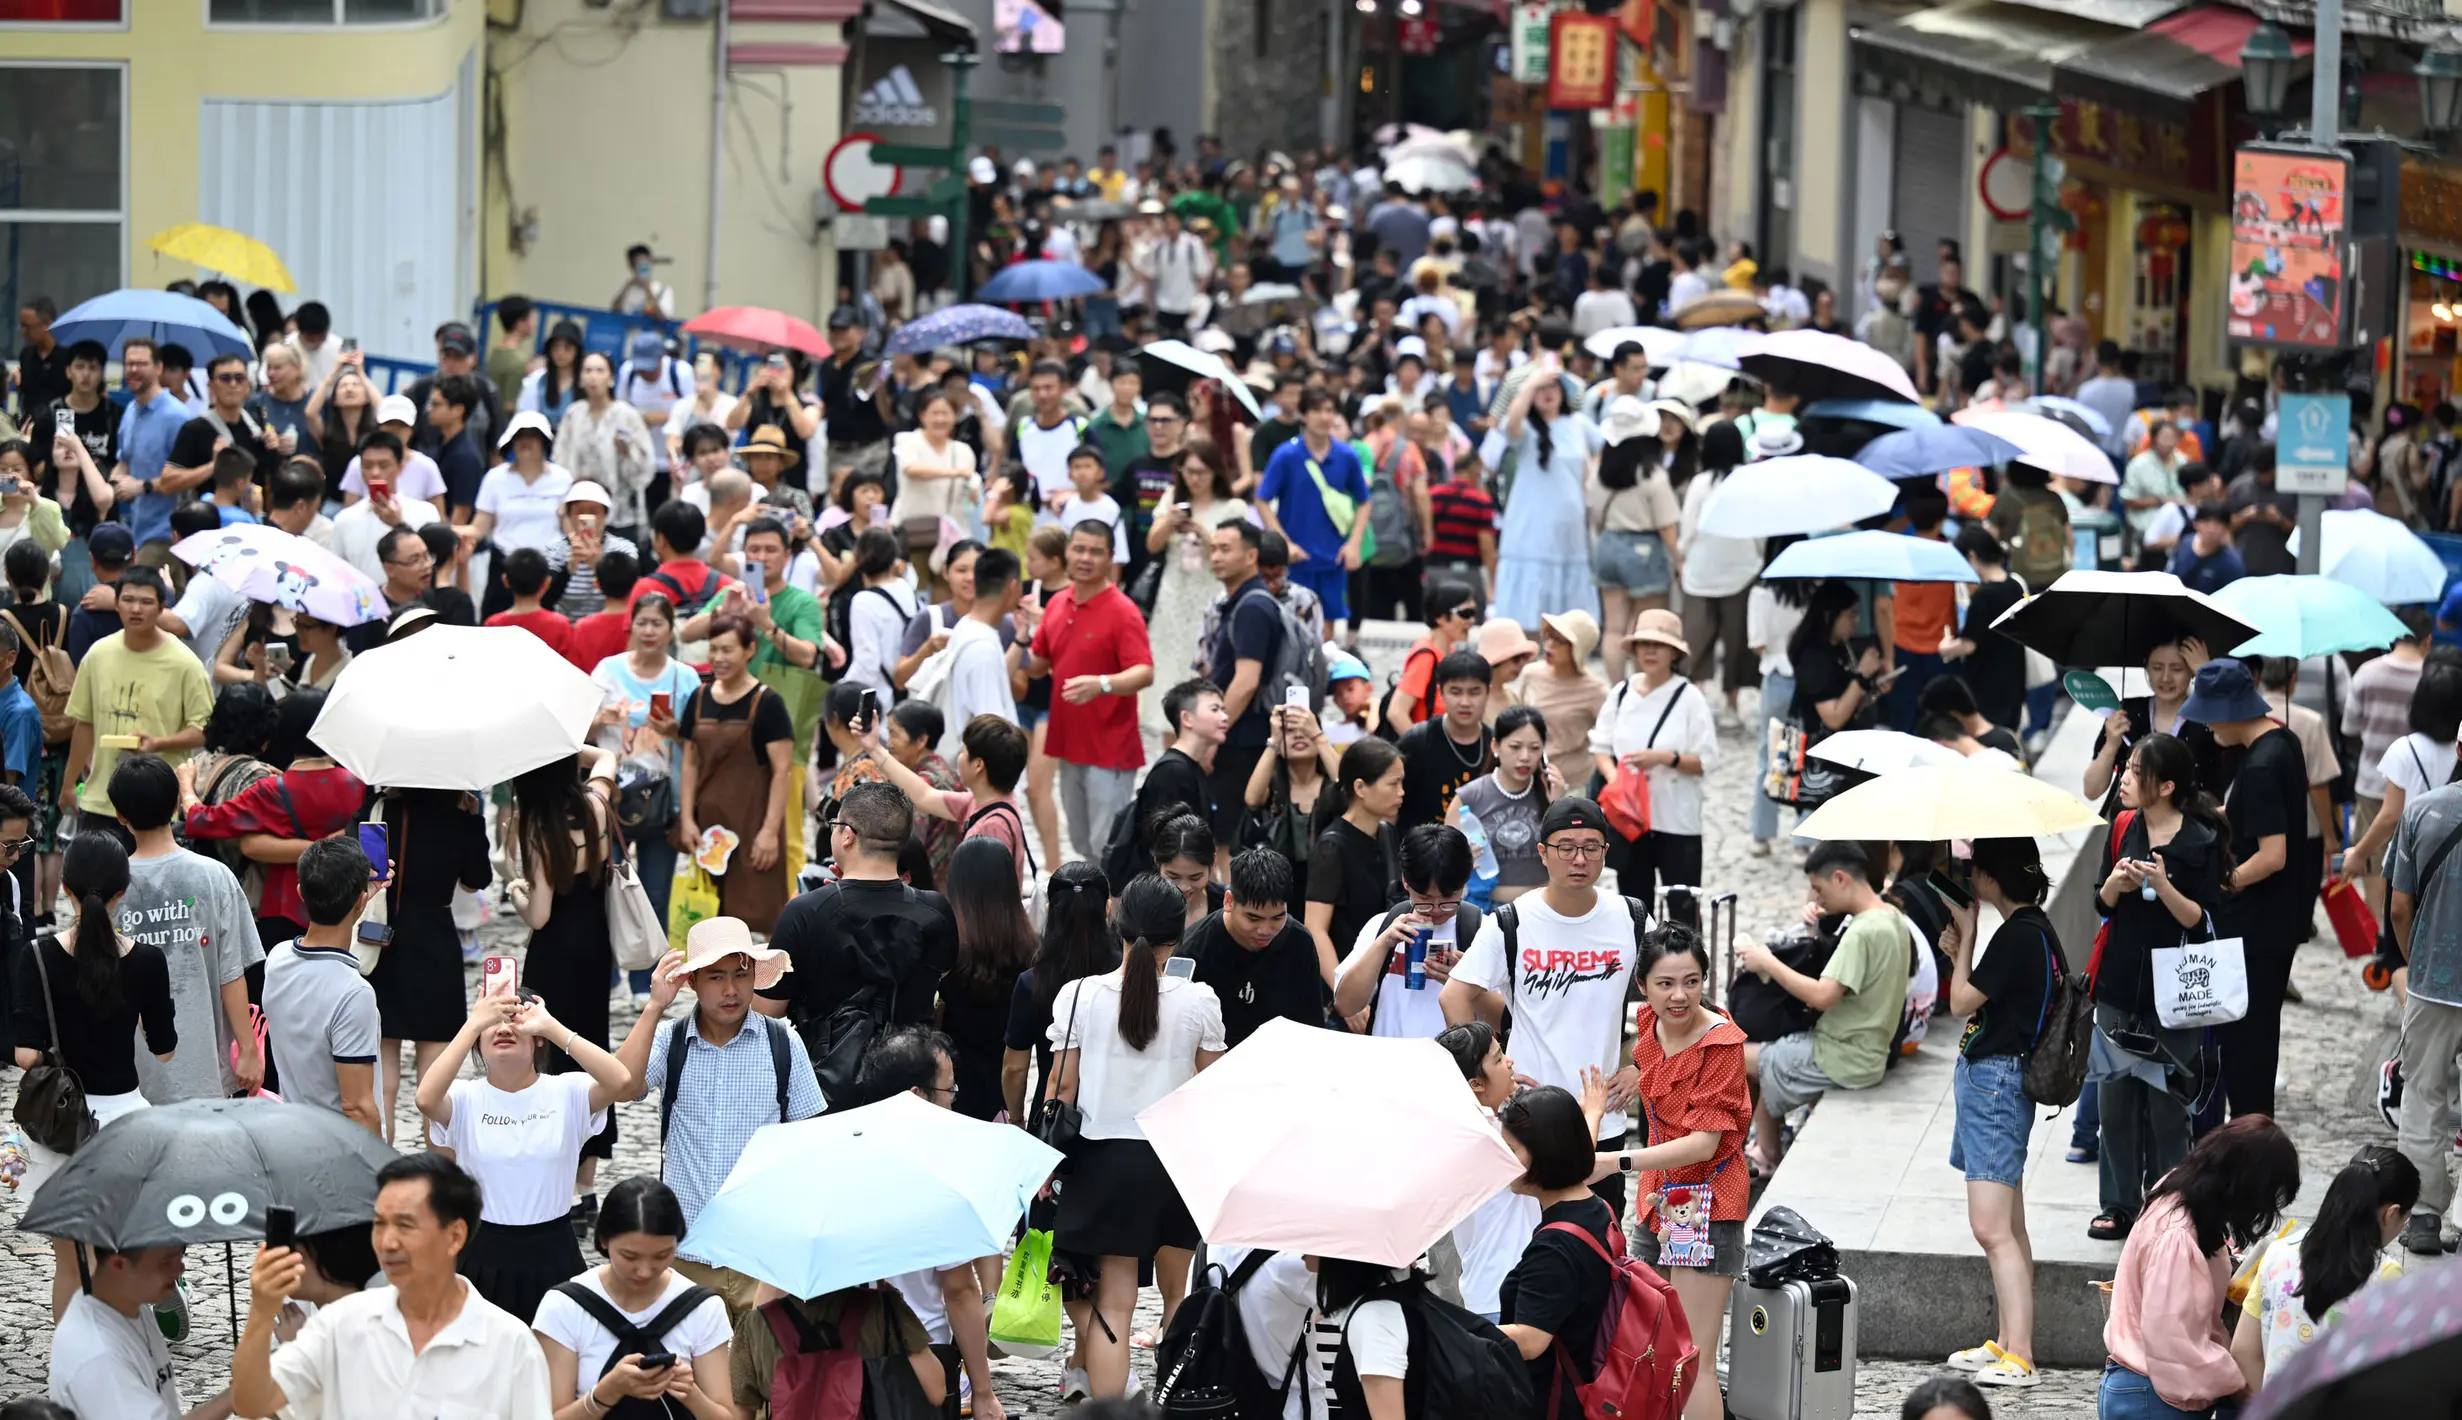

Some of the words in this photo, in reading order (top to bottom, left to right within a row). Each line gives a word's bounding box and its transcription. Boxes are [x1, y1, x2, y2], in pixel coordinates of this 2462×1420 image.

[122, 910, 144, 932] go
[147, 900, 189, 923] with
[1522, 948, 1624, 972] SUPREME
[2174, 954, 2217, 974] HUMAN
[2178, 989, 2214, 1002] MADE
[481, 1113, 518, 1126] FOLLOW
[521, 1114, 538, 1126] YUR
